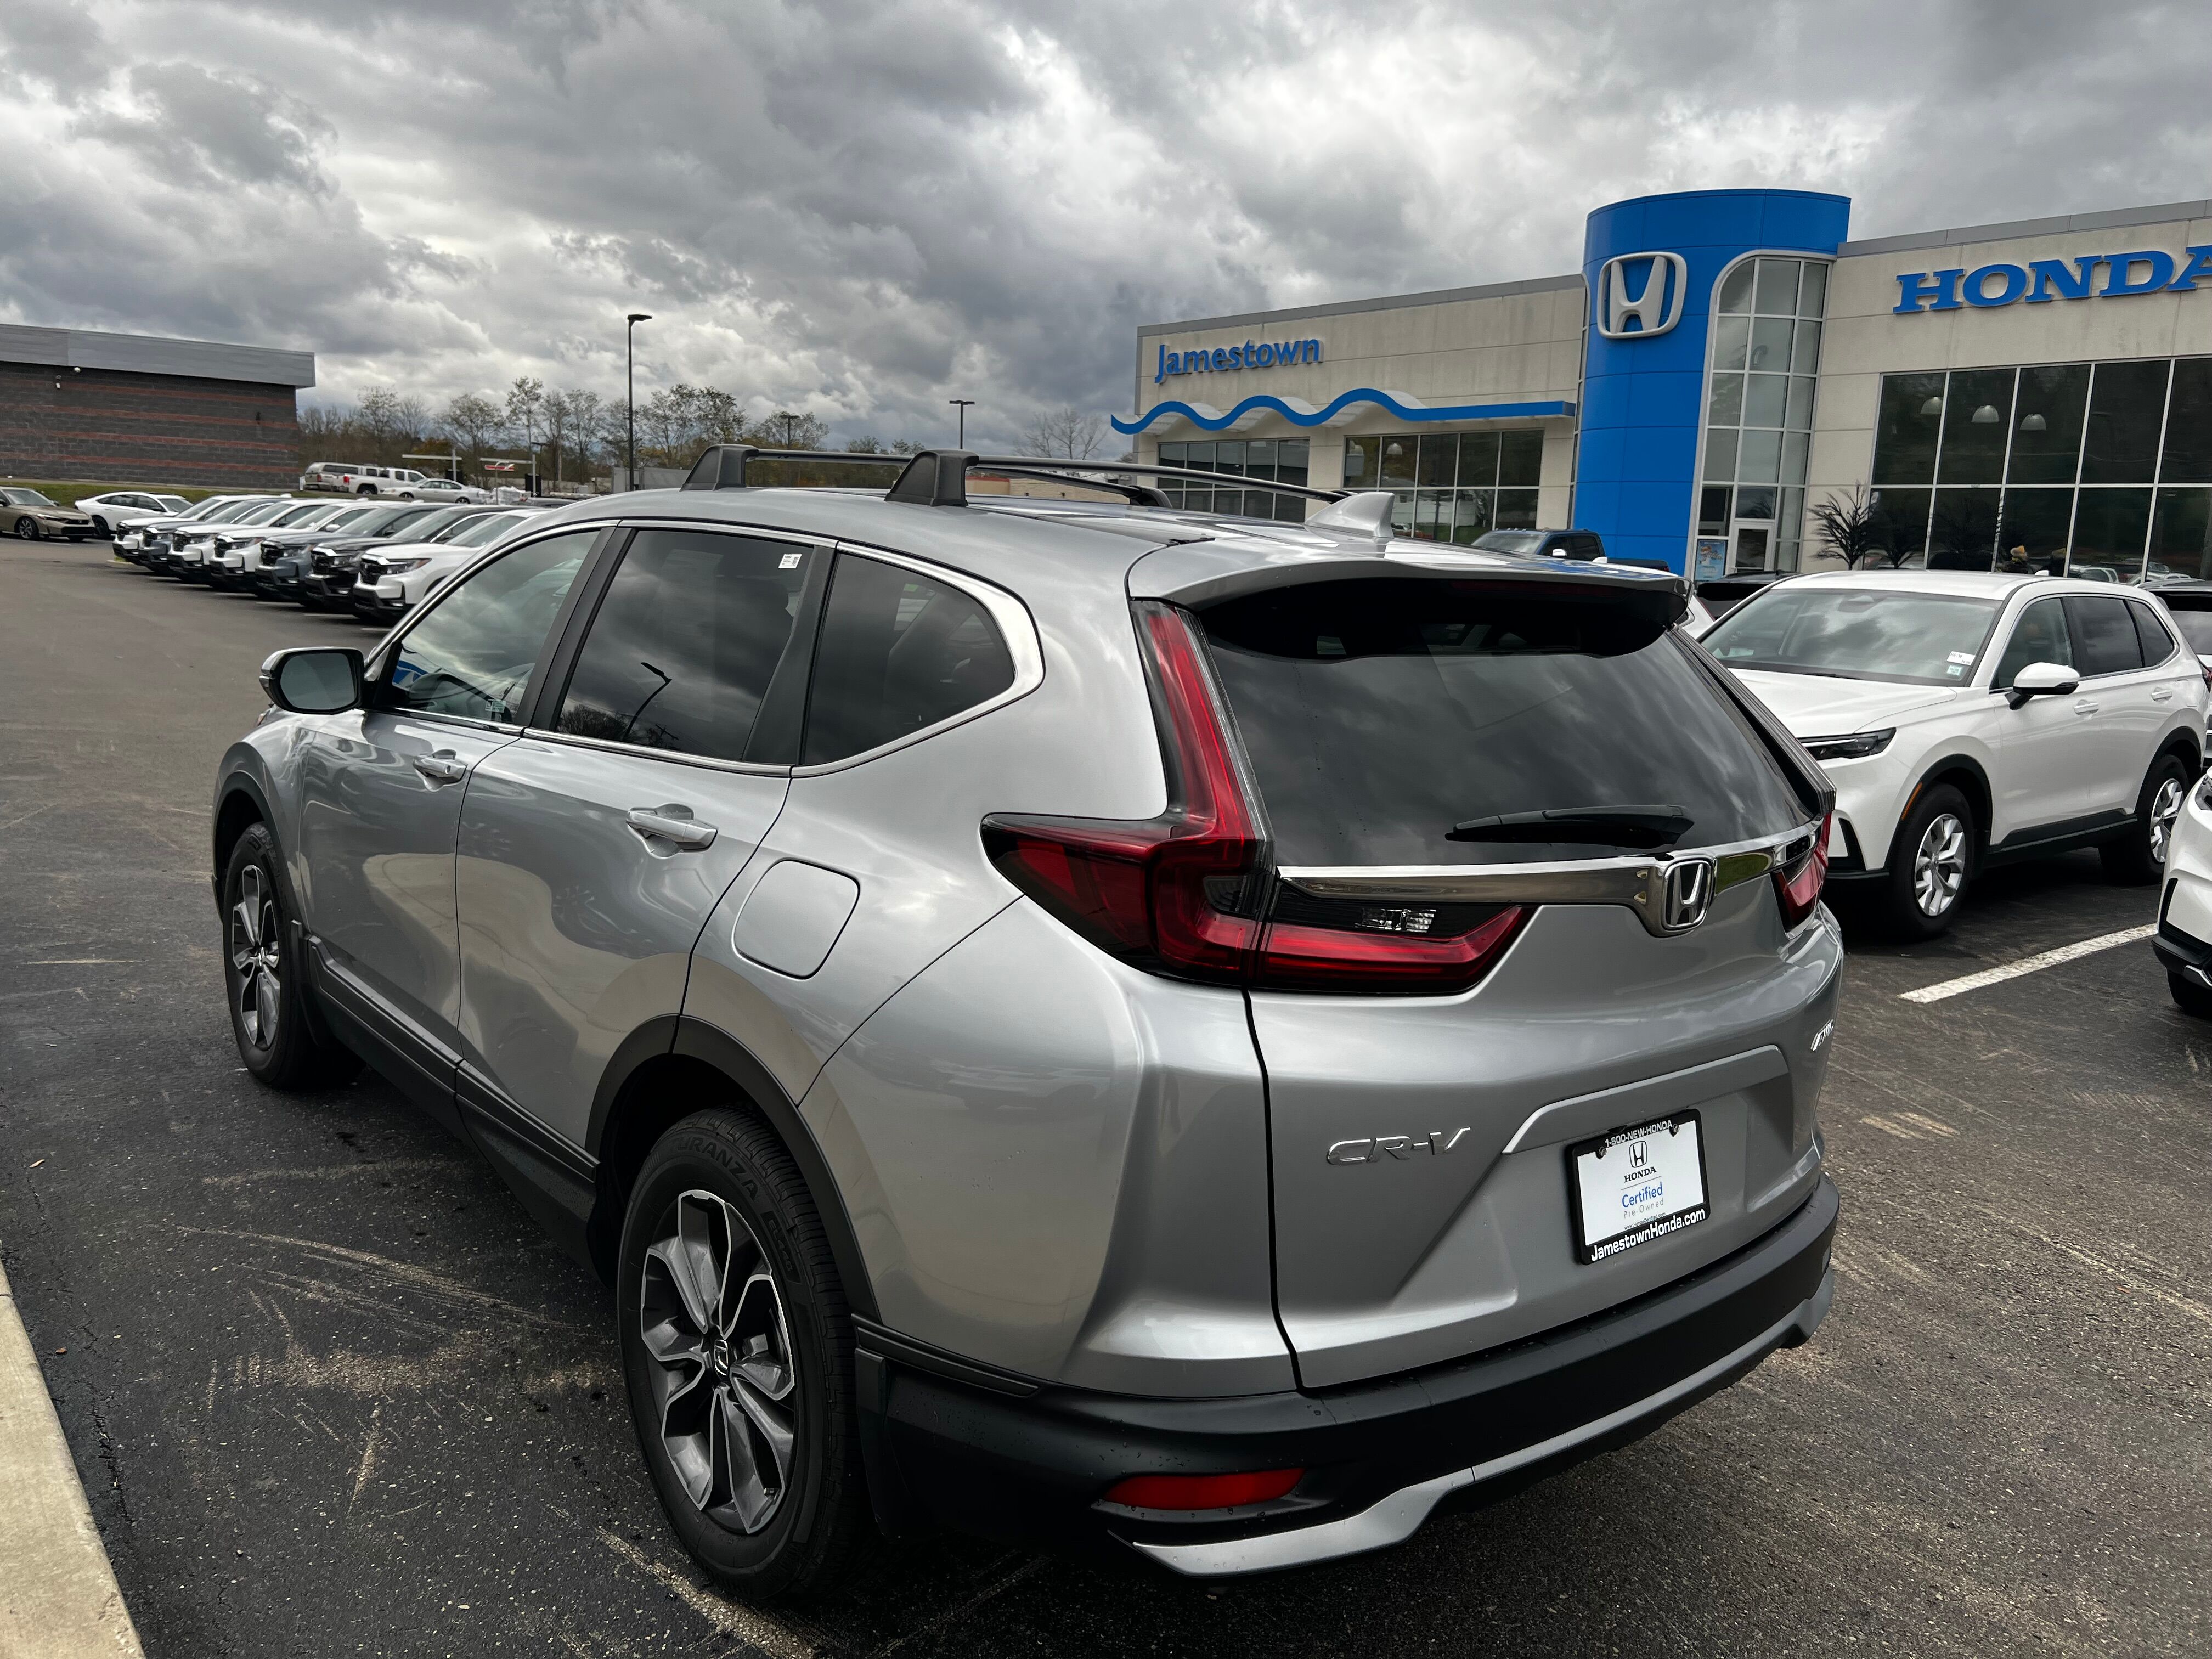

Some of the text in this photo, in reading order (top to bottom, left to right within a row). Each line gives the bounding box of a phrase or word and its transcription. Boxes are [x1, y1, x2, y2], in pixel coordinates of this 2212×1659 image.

[1892, 245, 2212, 314] HONDA
[1154, 338, 1322, 384] Jamestown
[1325, 1126, 1471, 1166] CR-V
[1624, 1166, 1657, 1183] HONDA
[1622, 1182, 1663, 1208] Certified
[1623, 1198, 1664, 1218] Pre-Owned
[1591, 1209, 1706, 1262] JamestownHonda.com
